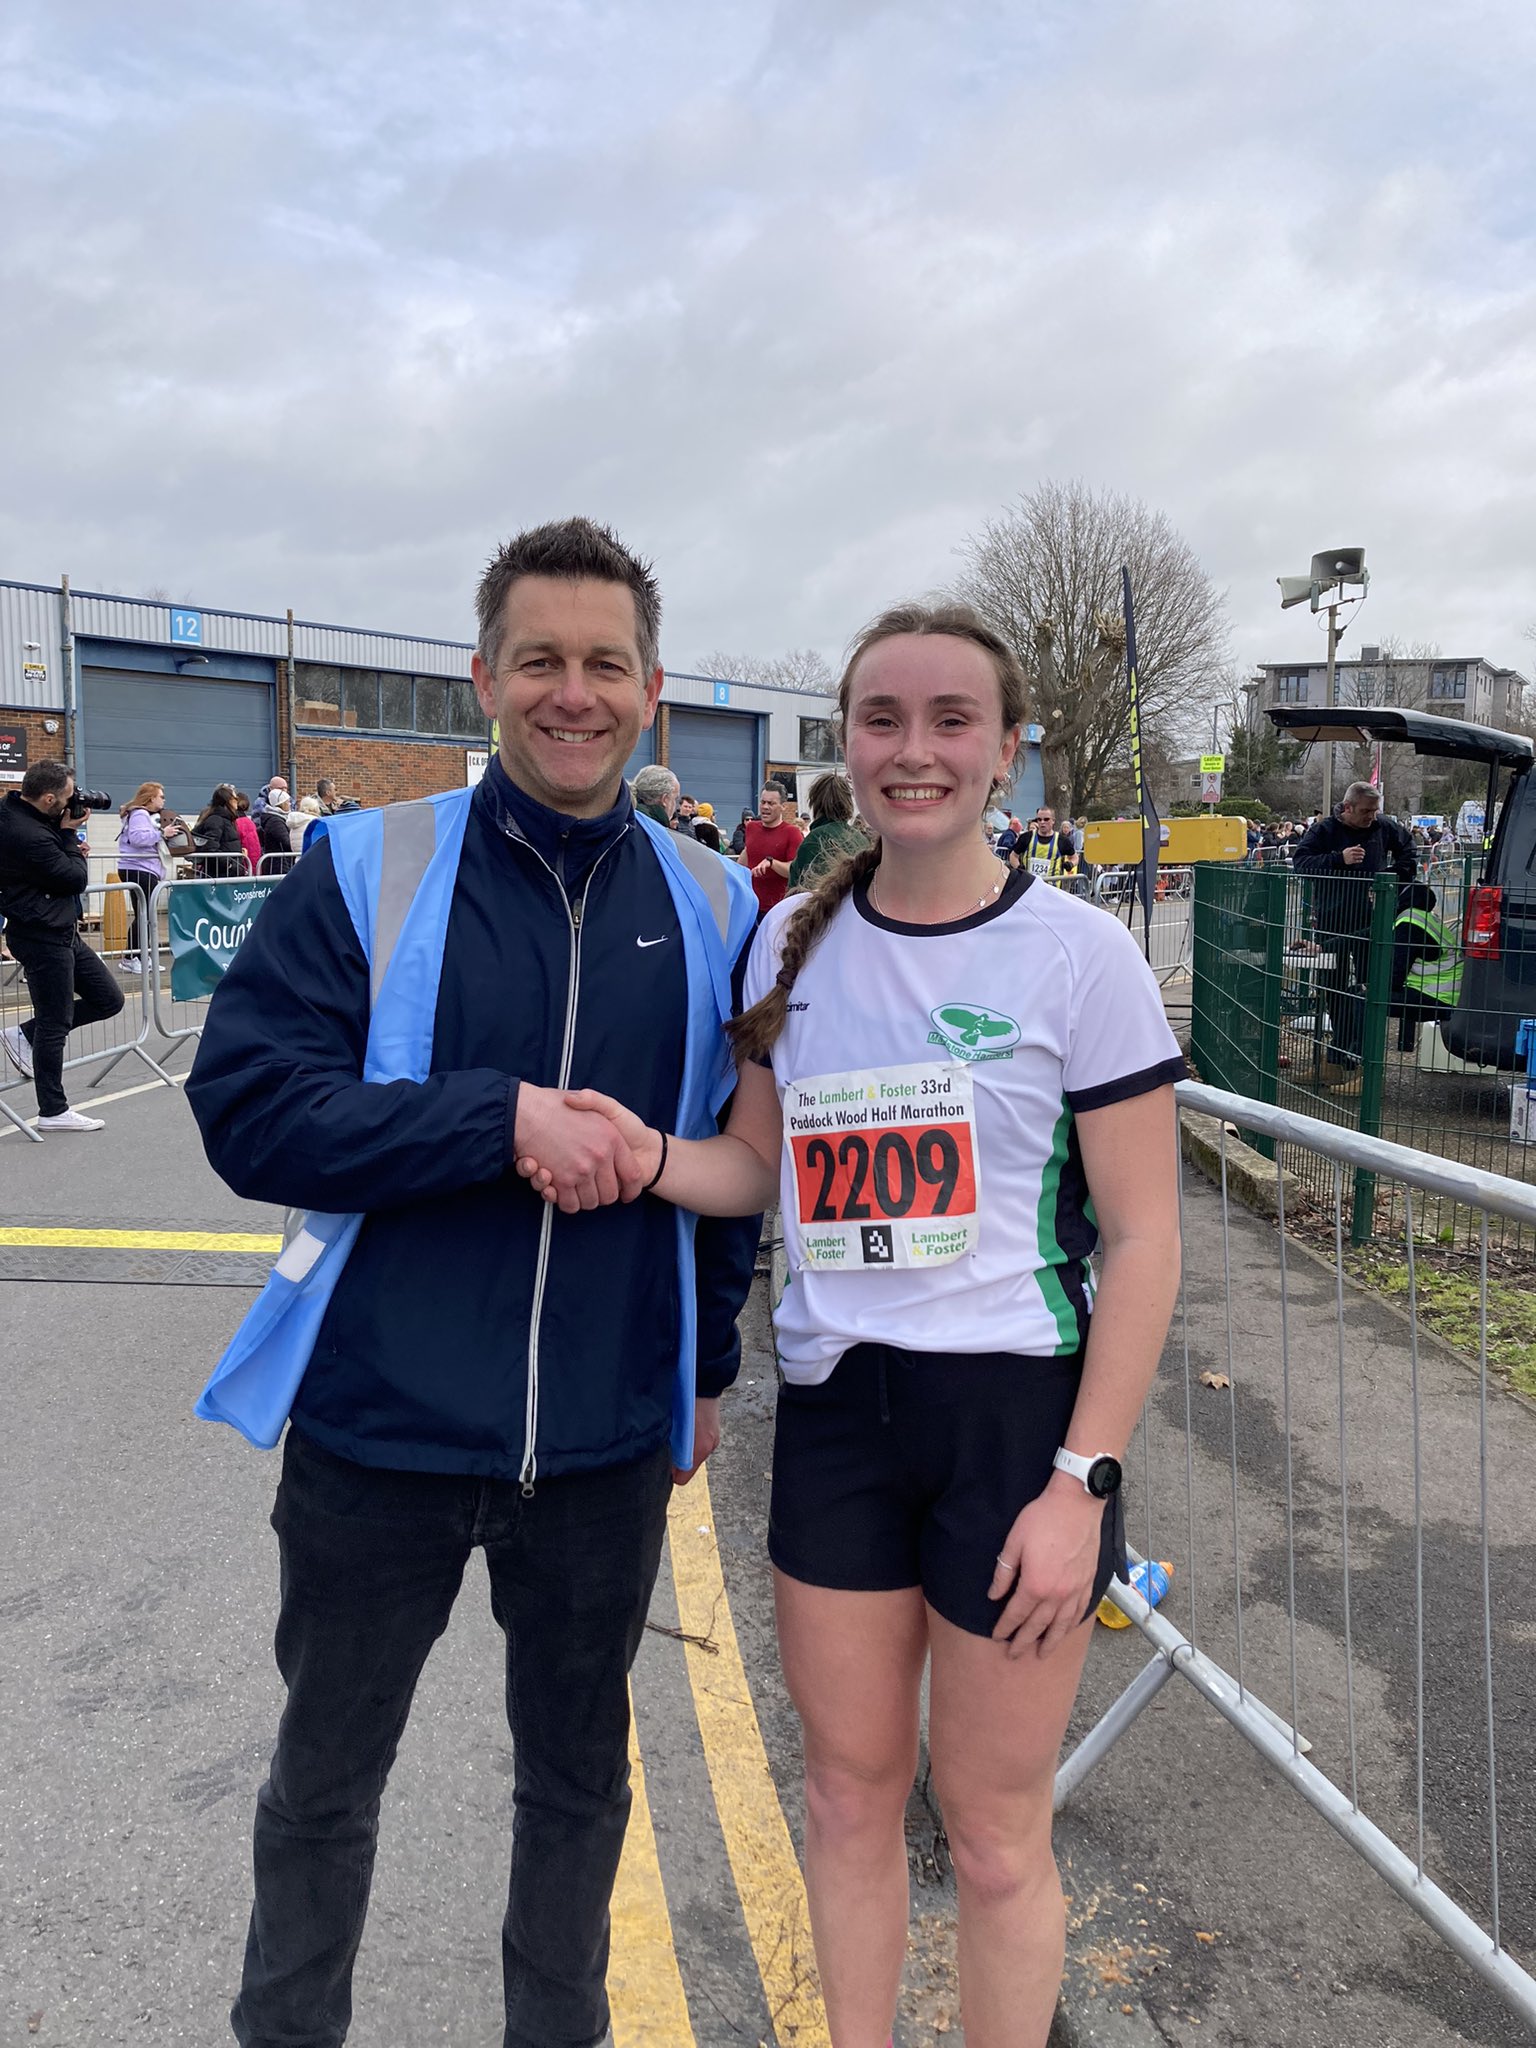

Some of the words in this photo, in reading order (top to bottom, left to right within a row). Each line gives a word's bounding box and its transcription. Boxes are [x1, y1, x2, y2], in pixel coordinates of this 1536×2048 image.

[176, 616, 198, 637] 12
[719, 687, 726, 701] 8
[1032, 864, 1049, 874] 1234
[798, 1092, 816, 1108] The
[819, 1087, 864, 1105] Lambert
[866, 1085, 876, 1099] &
[880, 1083, 917, 1099] Foster
[921, 1078, 951, 1095] 33rd
[790, 1112, 833, 1130] Paddock
[836, 1108, 867, 1125] Wood
[872, 1105, 898, 1122] Half
[900, 1101, 965, 1120] Marathon
[806, 1128, 960, 1221] 2209
[806, 1236, 846, 1248] Lambert
[912, 1228, 968, 1244] Lambert
[816, 1248, 846, 1260] Foster
[926, 1241, 967, 1256] Foster
